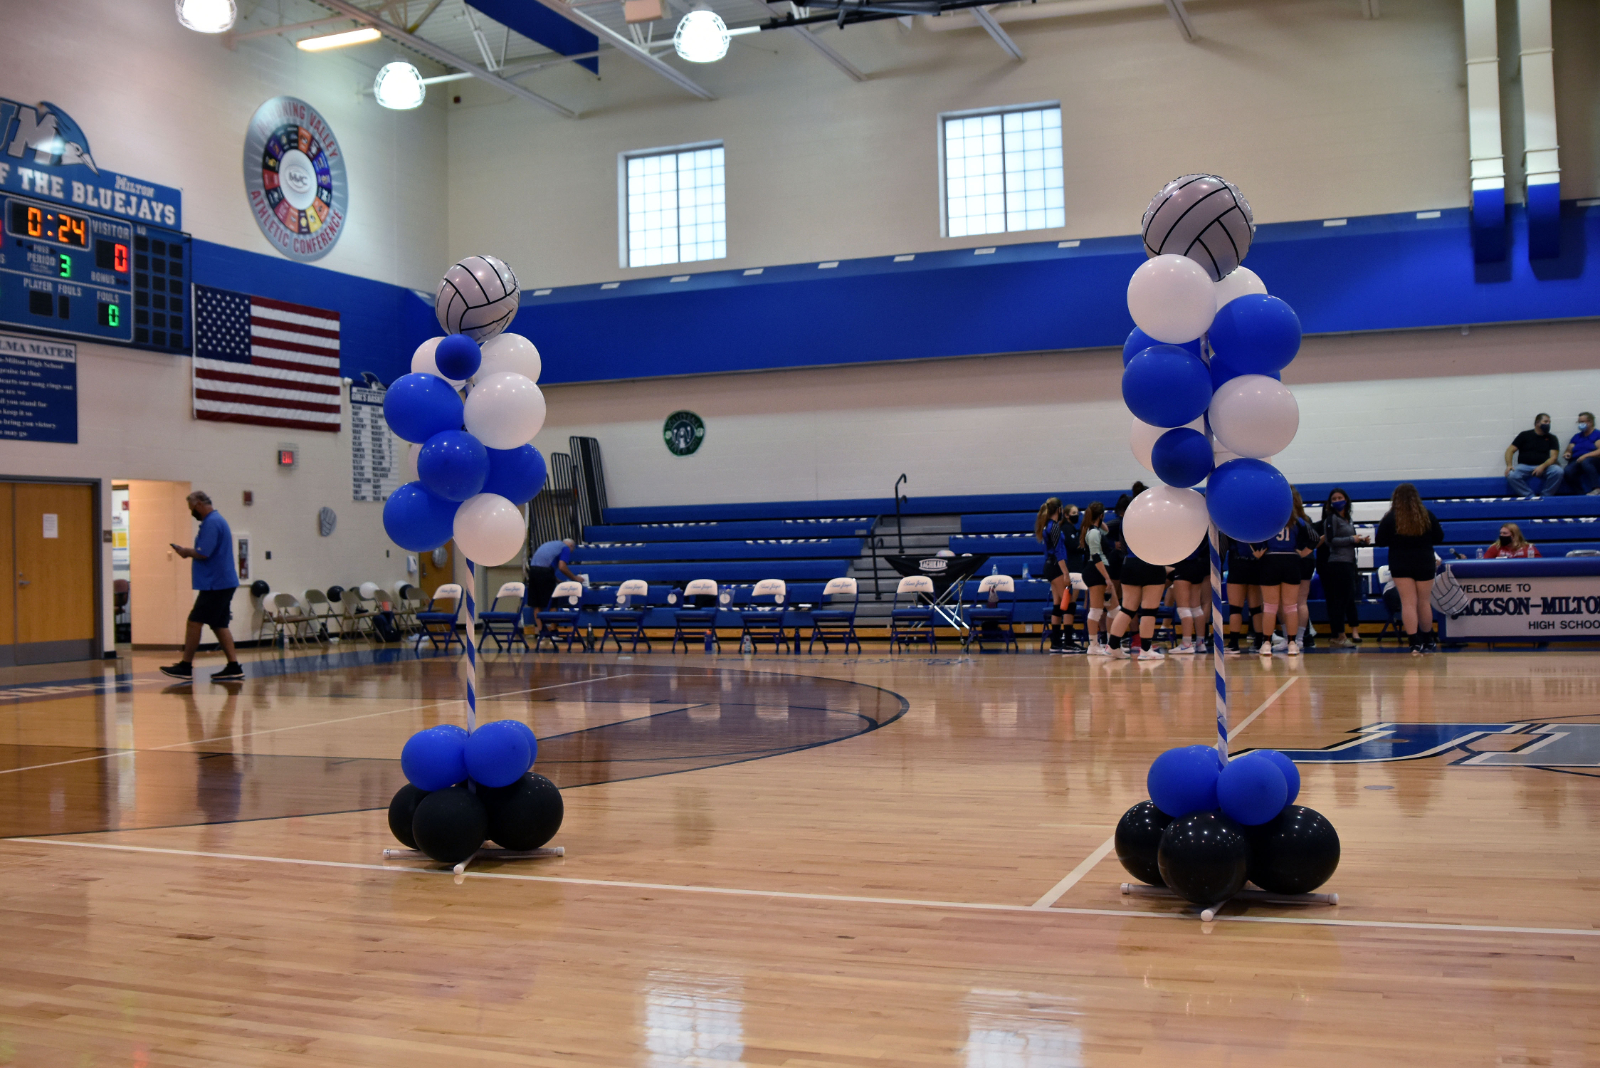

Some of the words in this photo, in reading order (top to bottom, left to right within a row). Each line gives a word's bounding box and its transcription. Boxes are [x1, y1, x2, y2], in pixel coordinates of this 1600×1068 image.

[309, 112, 338, 158] VALLEY
[18, 166, 64, 199] THE
[72, 181, 176, 226] BLUEJAYS
[28, 206, 86, 246] 0:24
[92, 219, 130, 240] VISITOR
[251, 190, 289, 248] ATHLETIC
[293, 208, 343, 254] CONFERENCE
[27, 252, 56, 267] PERIOD
[60, 254, 71, 278] 3
[114, 243, 128, 273] 0
[23, 278, 53, 292] PLAYER
[58, 284, 82, 298] FOULS
[91, 271, 116, 286] BONUS
[96, 291, 120, 304] FOULS
[108, 304, 120, 327] 0
[0, 340, 26, 352] LMA
[29, 344, 73, 358] MATER
[1459, 584, 1512, 593] WELCOME
[1516, 584, 1531, 592] TO
[1455, 596, 1600, 618] ACKSON-MILTO
[1528, 621, 1554, 630] HIGH
[1560, 620, 1600, 629] SCHOO
